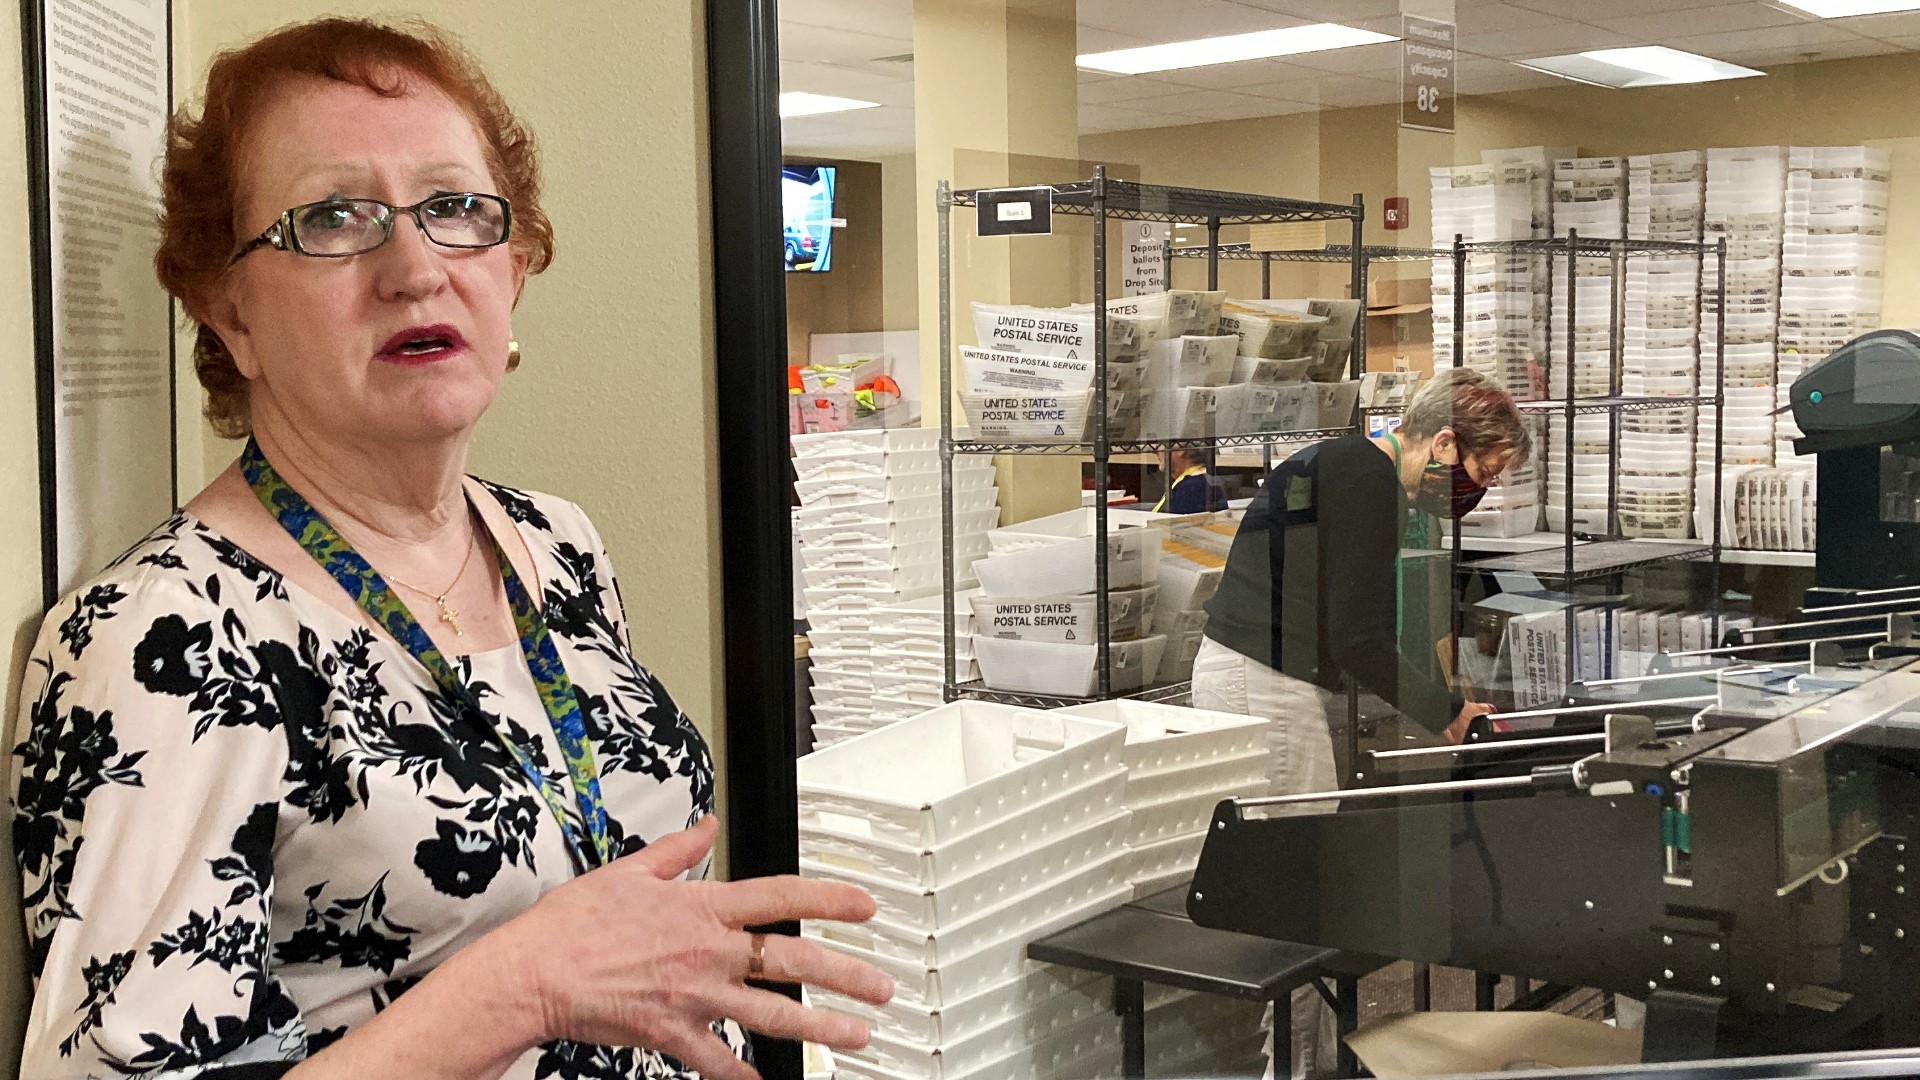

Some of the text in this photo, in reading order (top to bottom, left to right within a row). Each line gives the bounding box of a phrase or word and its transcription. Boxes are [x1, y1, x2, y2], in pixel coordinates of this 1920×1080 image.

[1130, 243, 1163, 254] Deposit
[1133, 255, 1161, 264] ballots
[1136, 266, 1157, 275] from
[1125, 279, 1147, 289] Drop
[1106, 305, 1138, 315] TATES
[997, 316, 1079, 333] UNITED STATES
[993, 328, 1083, 346] POSTAL SERVICE
[964, 350, 1088, 371] UNITED STATES POSTAL SERVICE
[1009, 367, 1036, 376] WARNING
[984, 398, 1058, 409] UNITED STATES
[982, 410, 1066, 421] POSTAL SERVICE
[996, 604, 1072, 614] UNITED STATES
[994, 616, 1077, 627] POSTAL SERVICE
[1526, 628, 1539, 704] POSTAL SERVICE
[1536, 632, 1548, 701] UNITED STATES
